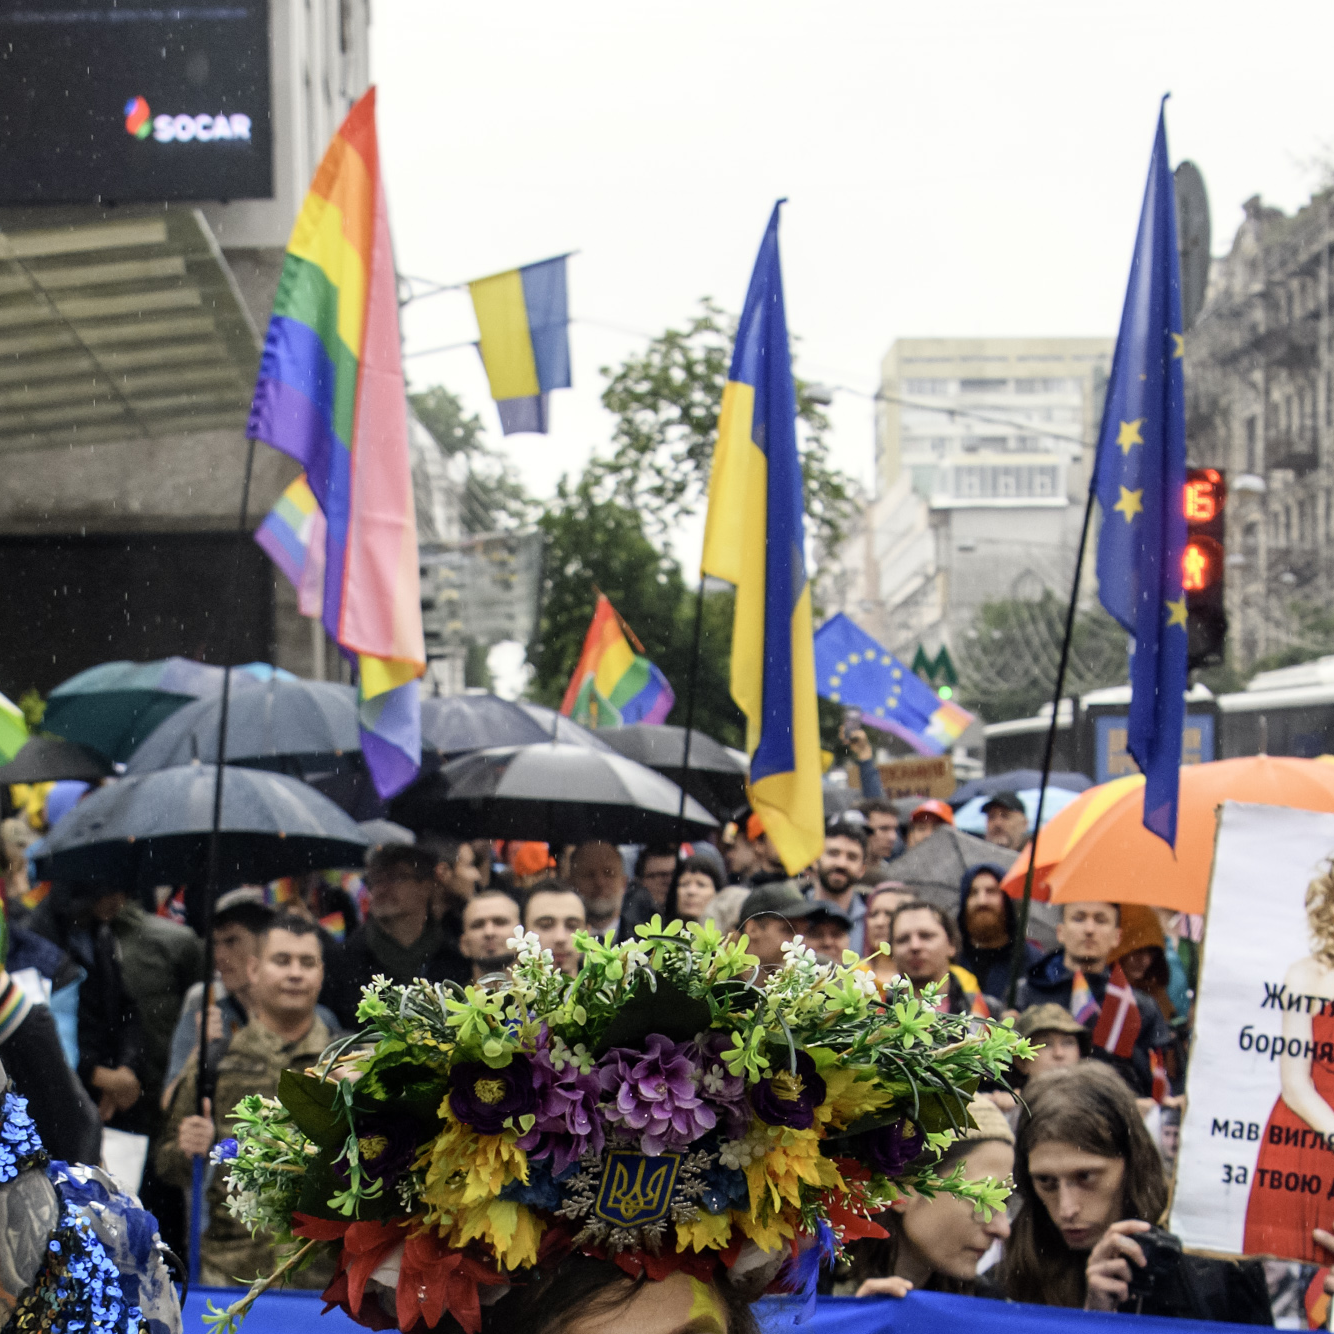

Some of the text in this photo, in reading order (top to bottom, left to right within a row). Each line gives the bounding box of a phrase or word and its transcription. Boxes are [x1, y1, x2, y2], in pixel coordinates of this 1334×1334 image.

[153, 113, 251, 142] SOCAR
[1210, 1118, 1260, 1141] мав
[1221, 1164, 1249, 1185] за
[1257, 1167, 1322, 1195] твою
